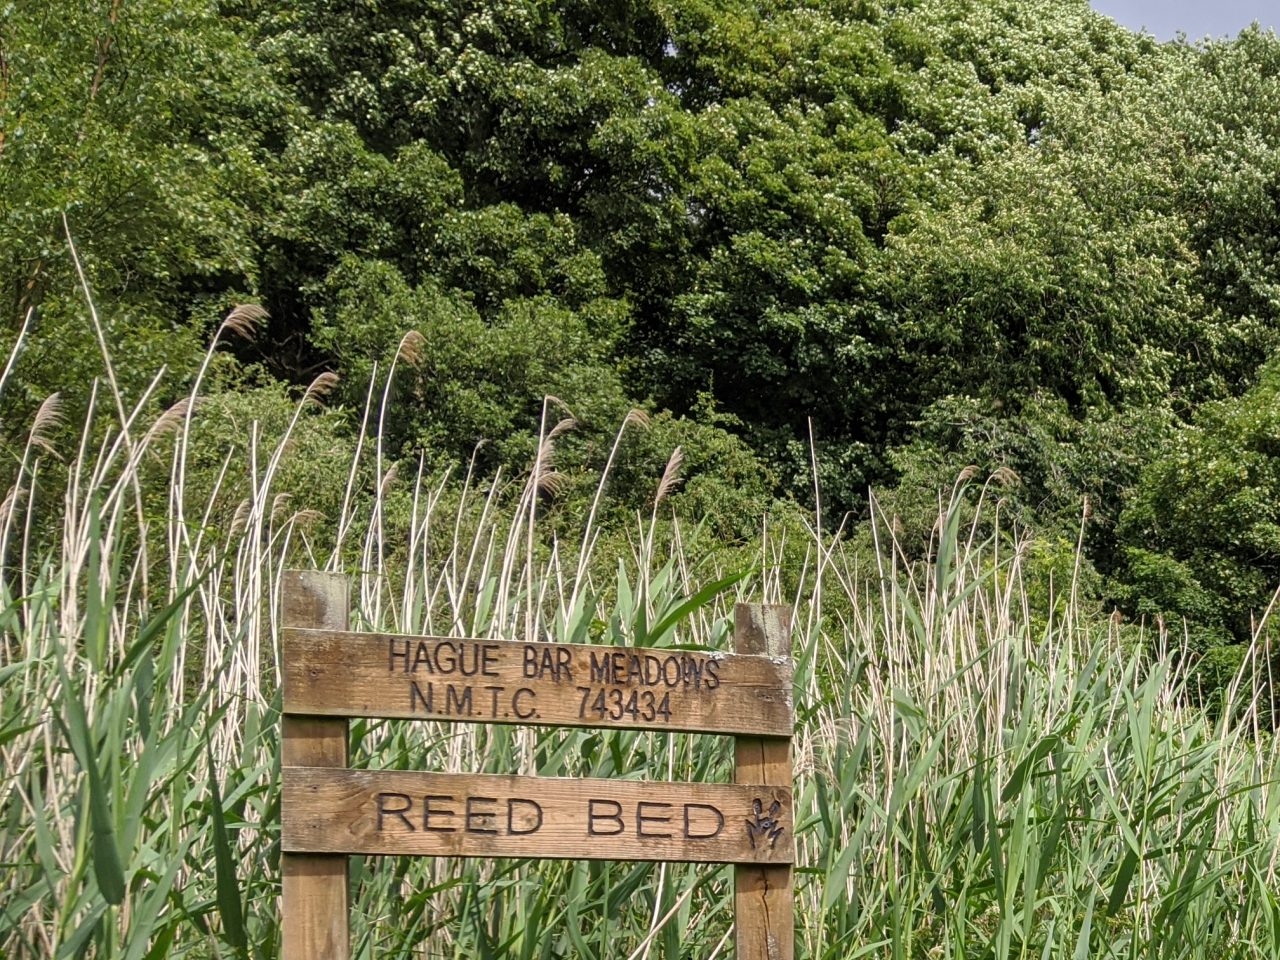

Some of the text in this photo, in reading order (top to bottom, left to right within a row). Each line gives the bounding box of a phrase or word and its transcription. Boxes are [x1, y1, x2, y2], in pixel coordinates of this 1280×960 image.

[389, 639, 720, 691] HAGUE BAR MEADOWS
[576, 686, 673, 723] 743434
[375, 792, 725, 839] REED BED
